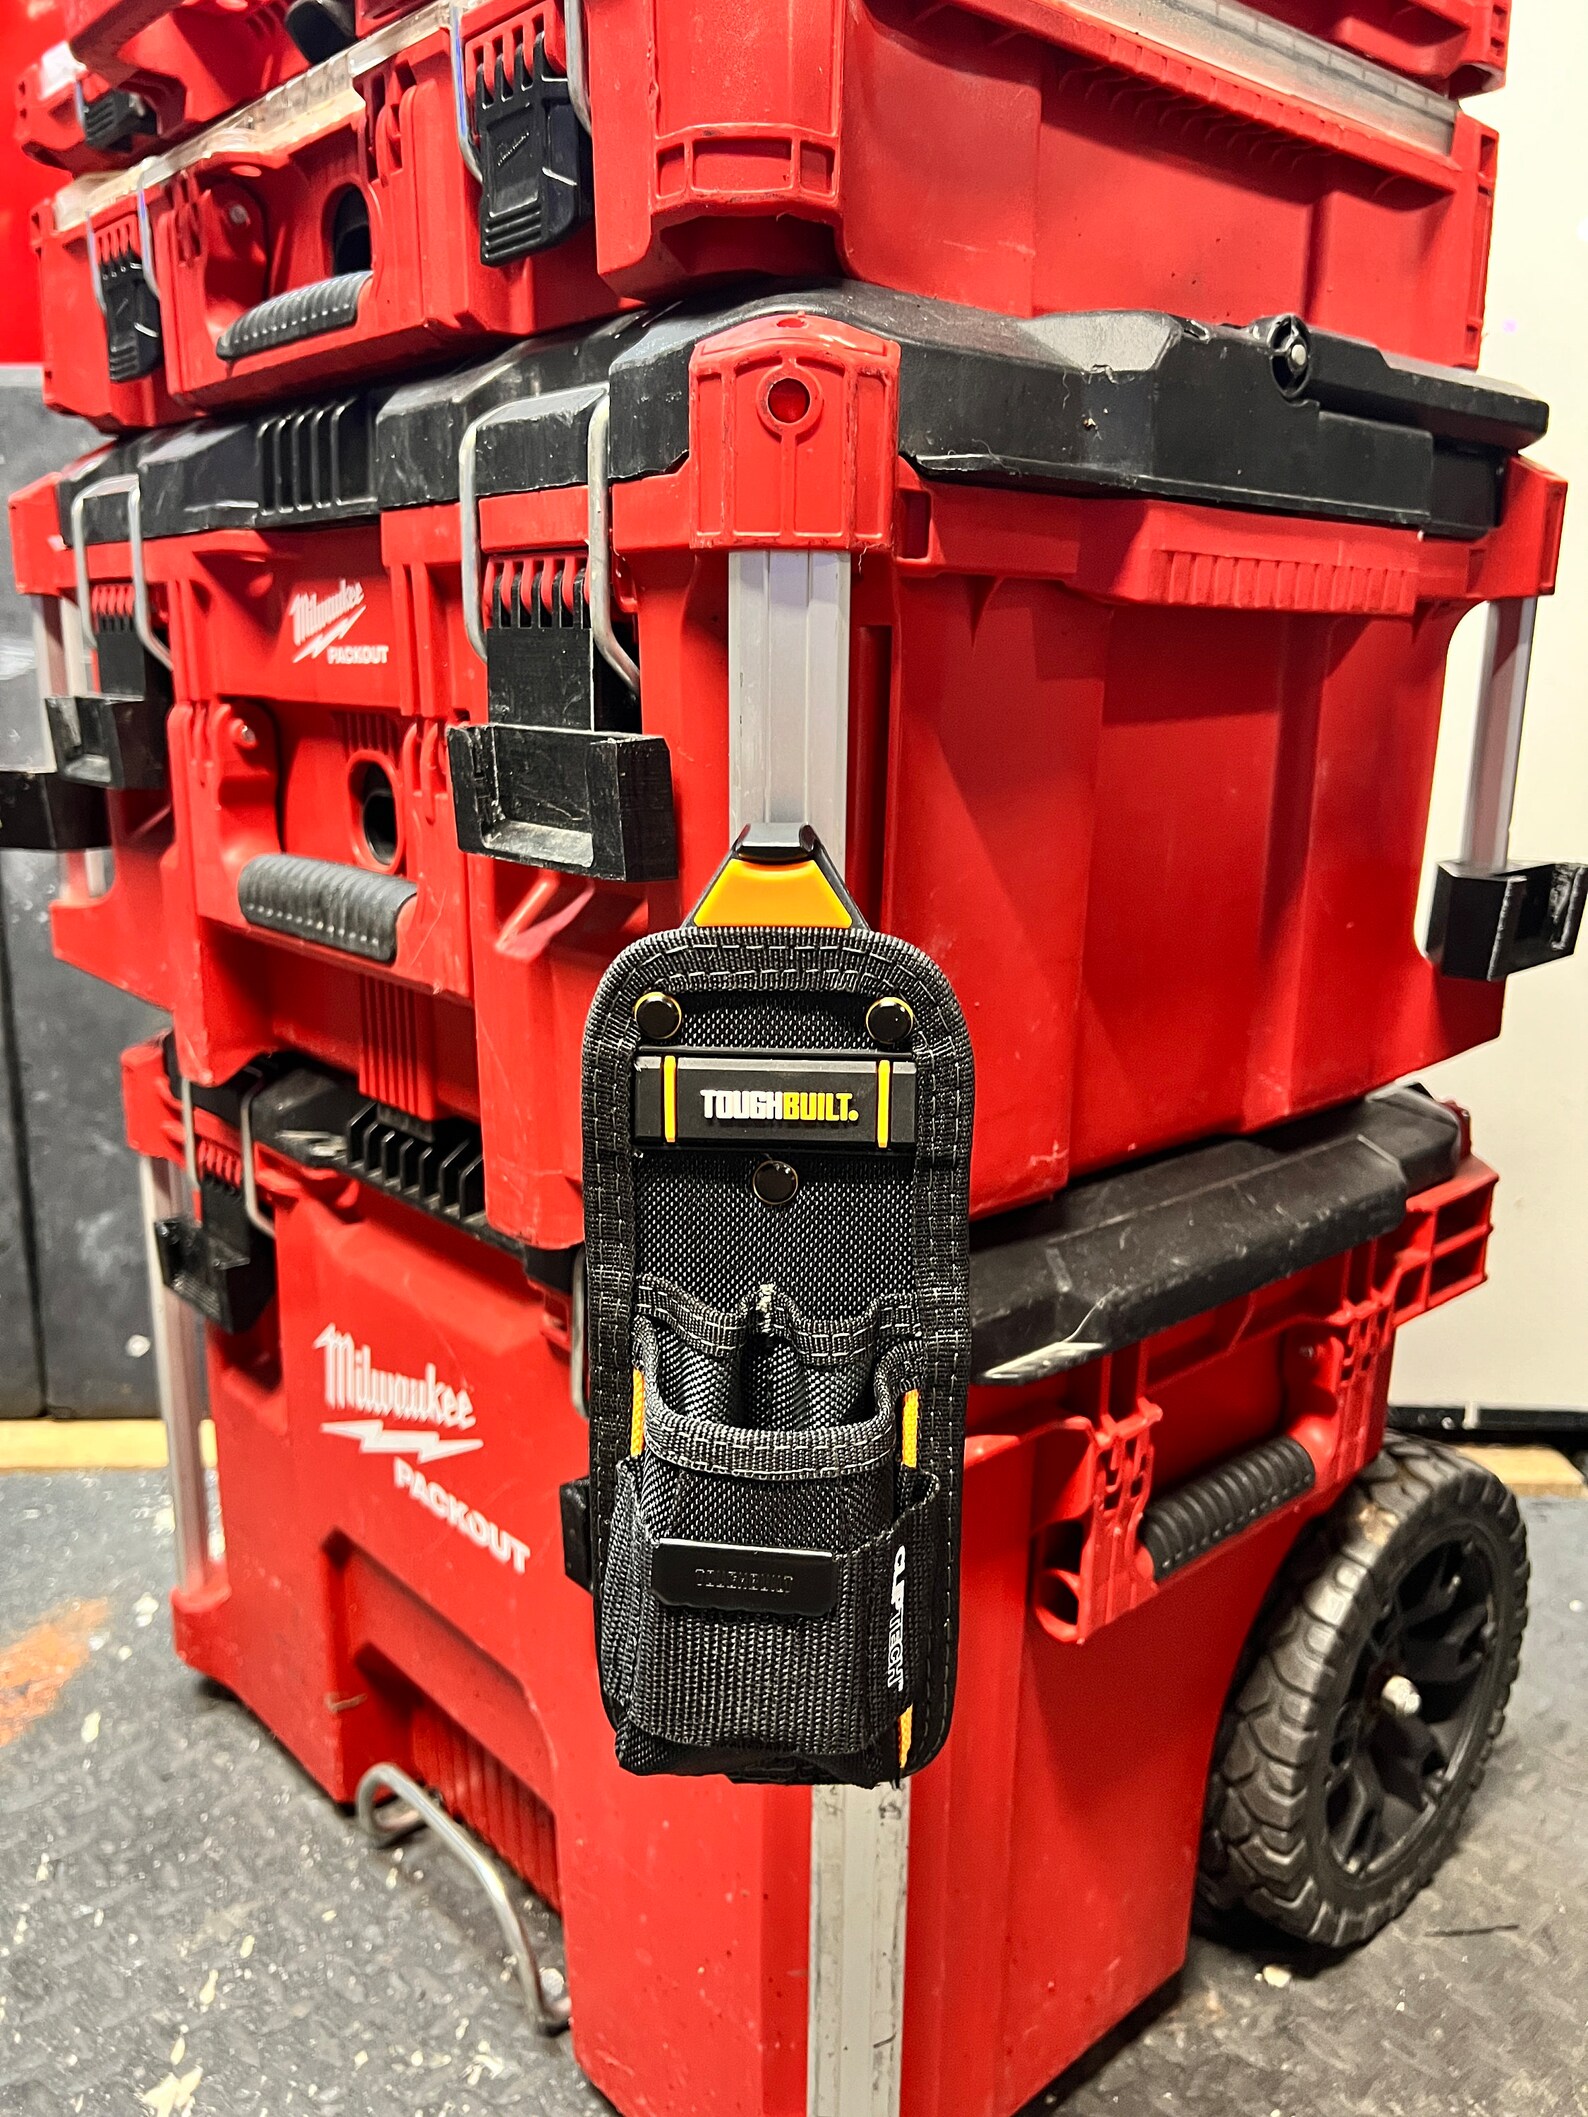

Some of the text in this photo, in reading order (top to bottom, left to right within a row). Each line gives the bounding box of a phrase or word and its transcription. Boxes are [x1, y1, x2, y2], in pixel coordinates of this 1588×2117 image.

[289, 579, 365, 647] Milwaukee
[327, 645, 389, 664] PACKOUT
[313, 1322, 476, 1430] Milwaukee
[393, 1456, 531, 1574] PACKOUT
